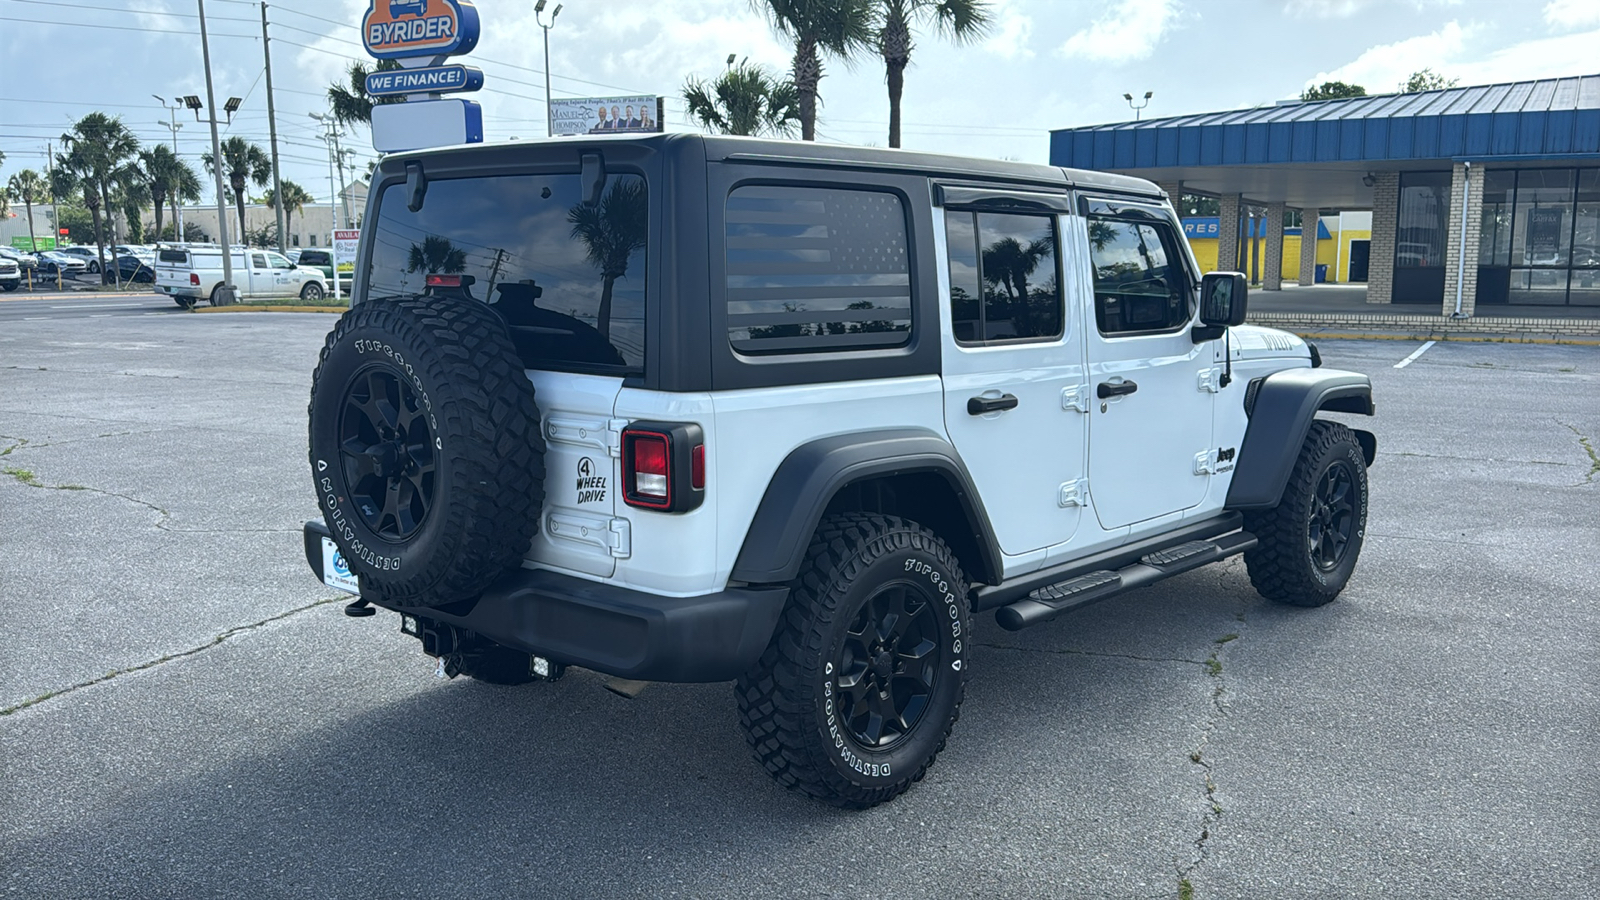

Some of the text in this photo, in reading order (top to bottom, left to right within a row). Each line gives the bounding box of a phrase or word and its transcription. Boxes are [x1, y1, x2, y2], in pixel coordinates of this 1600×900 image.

[369, 16, 452, 45] BYRIDER
[370, 70, 461, 89] WE FINANCE!
[551, 119, 587, 129] THOMPSON
[1185, 224, 1218, 233] RES
[576, 476, 607, 490] WHEEL
[577, 490, 607, 504] DRIVE
[321, 477, 401, 571] DESTINATION
[824, 681, 891, 777] DESTINATION
